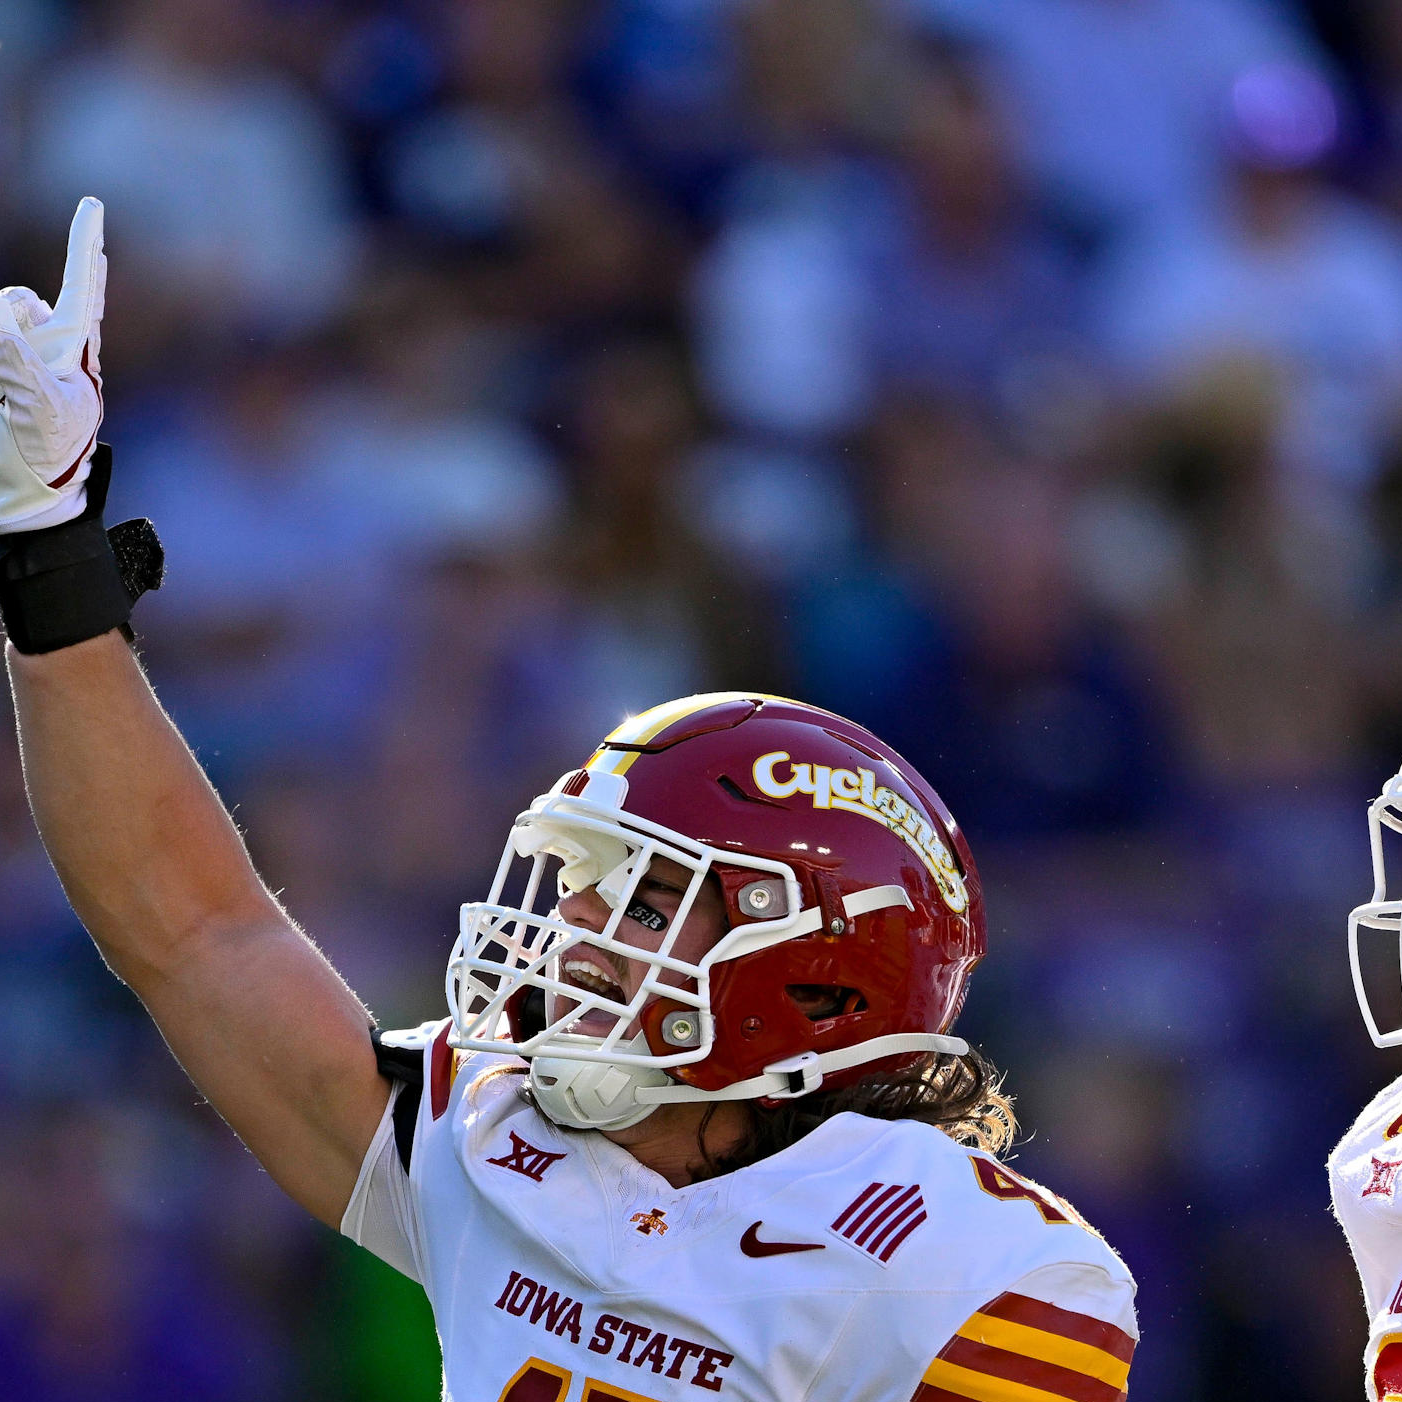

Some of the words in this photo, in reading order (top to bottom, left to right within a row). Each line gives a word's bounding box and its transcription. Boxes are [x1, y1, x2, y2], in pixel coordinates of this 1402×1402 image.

[752, 751, 970, 914] Cyclones
[627, 906, 662, 929] 15:13
[486, 1130, 567, 1182] XII
[494, 1271, 582, 1345] IOWA
[588, 1315, 735, 1393] STATE
